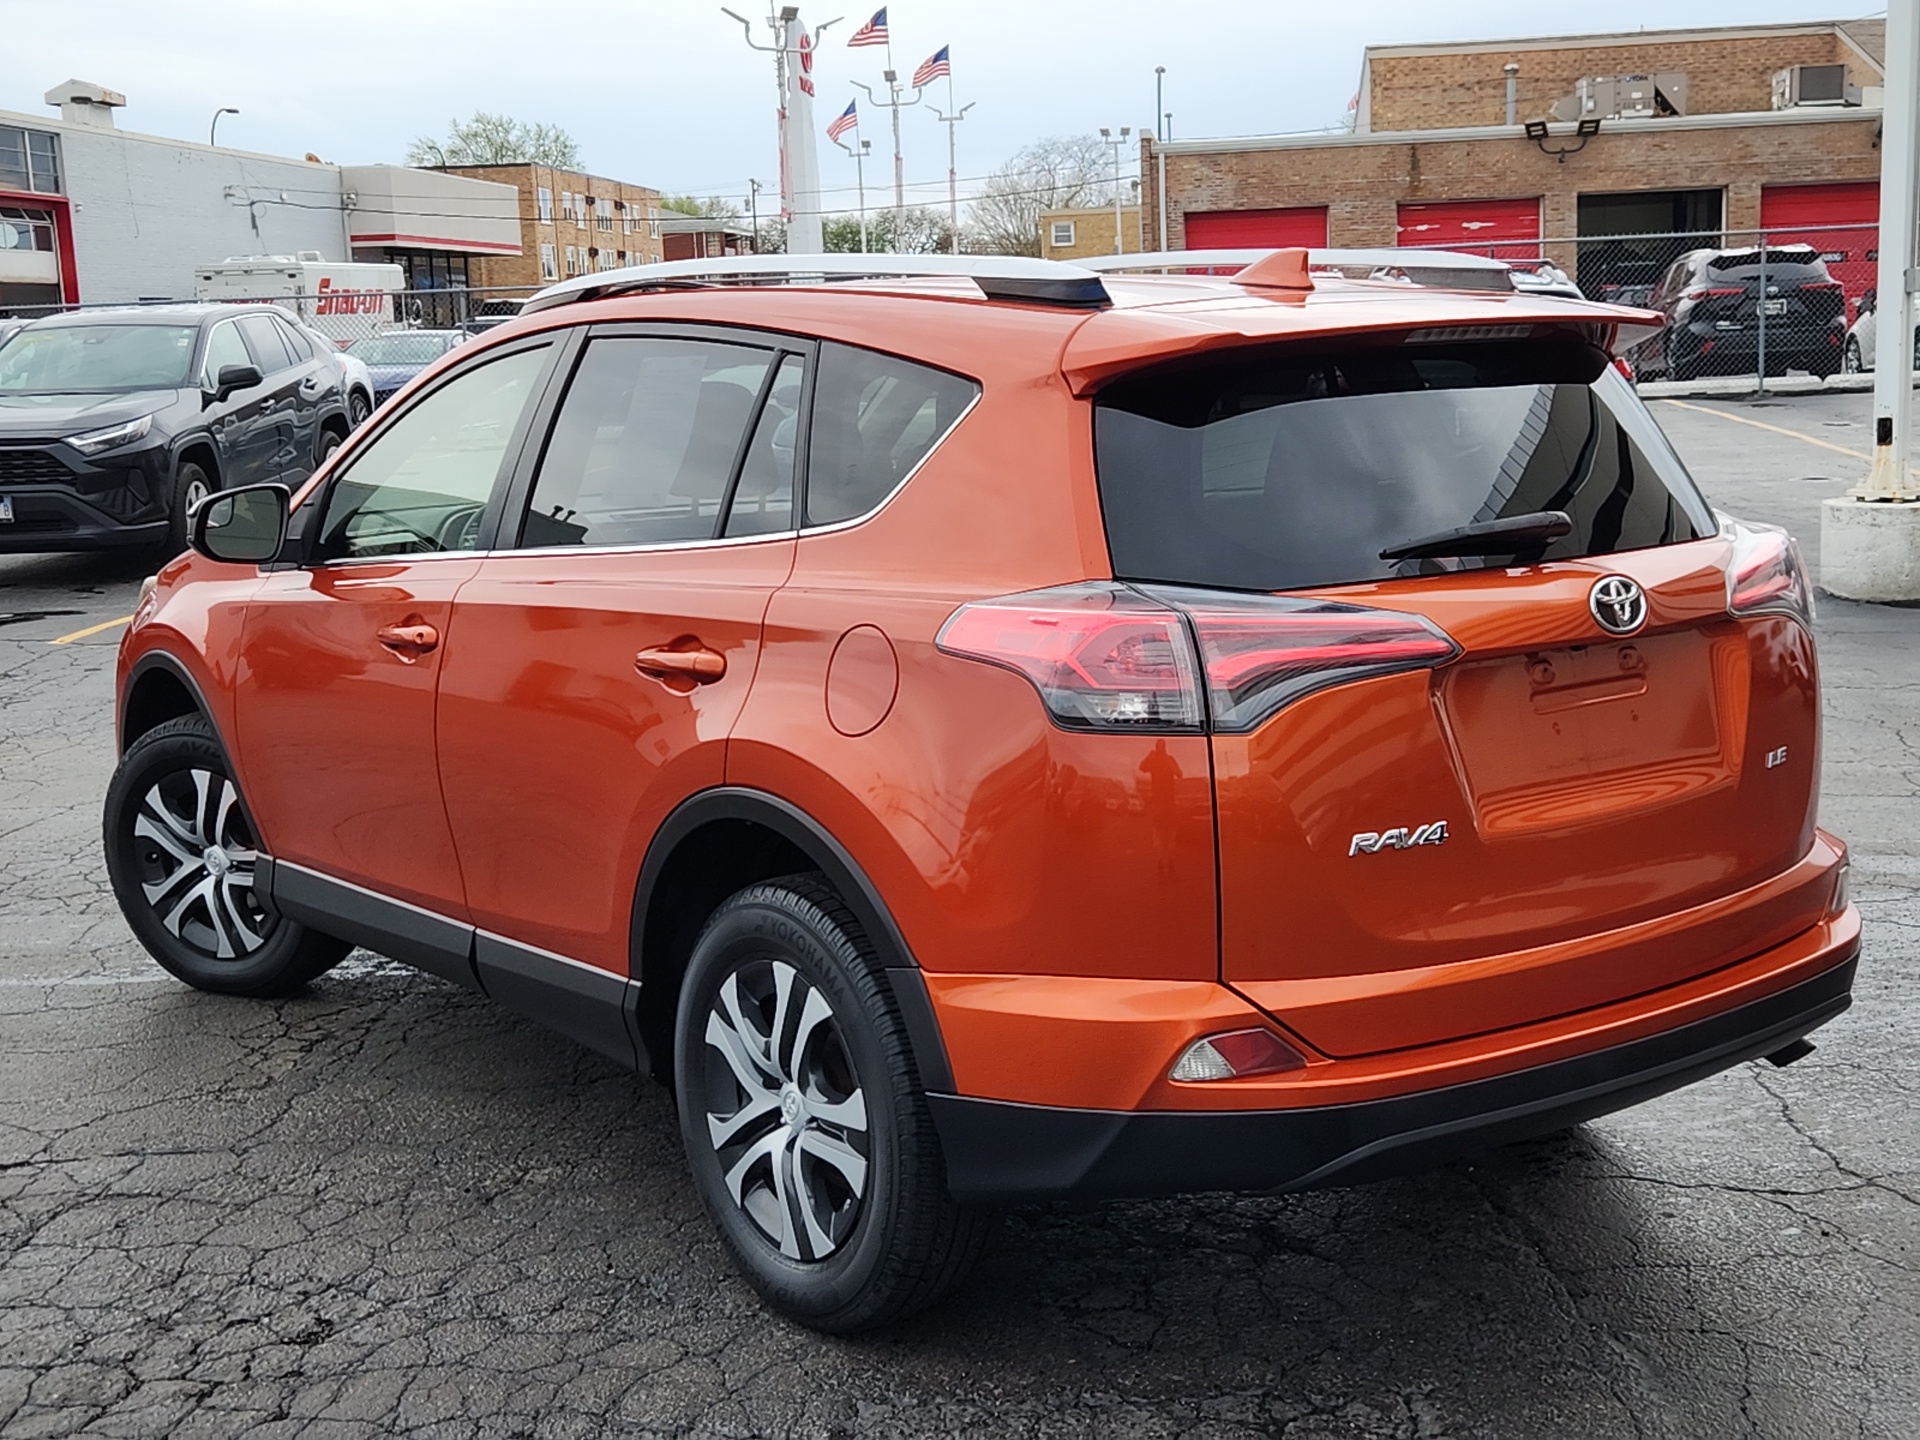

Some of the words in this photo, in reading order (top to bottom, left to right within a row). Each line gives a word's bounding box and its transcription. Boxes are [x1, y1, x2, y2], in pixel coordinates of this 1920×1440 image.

[1765, 746, 1787, 768] LE
[1349, 820, 1449, 856] RAV4
[771, 919, 845, 996] YOKOHAMA
